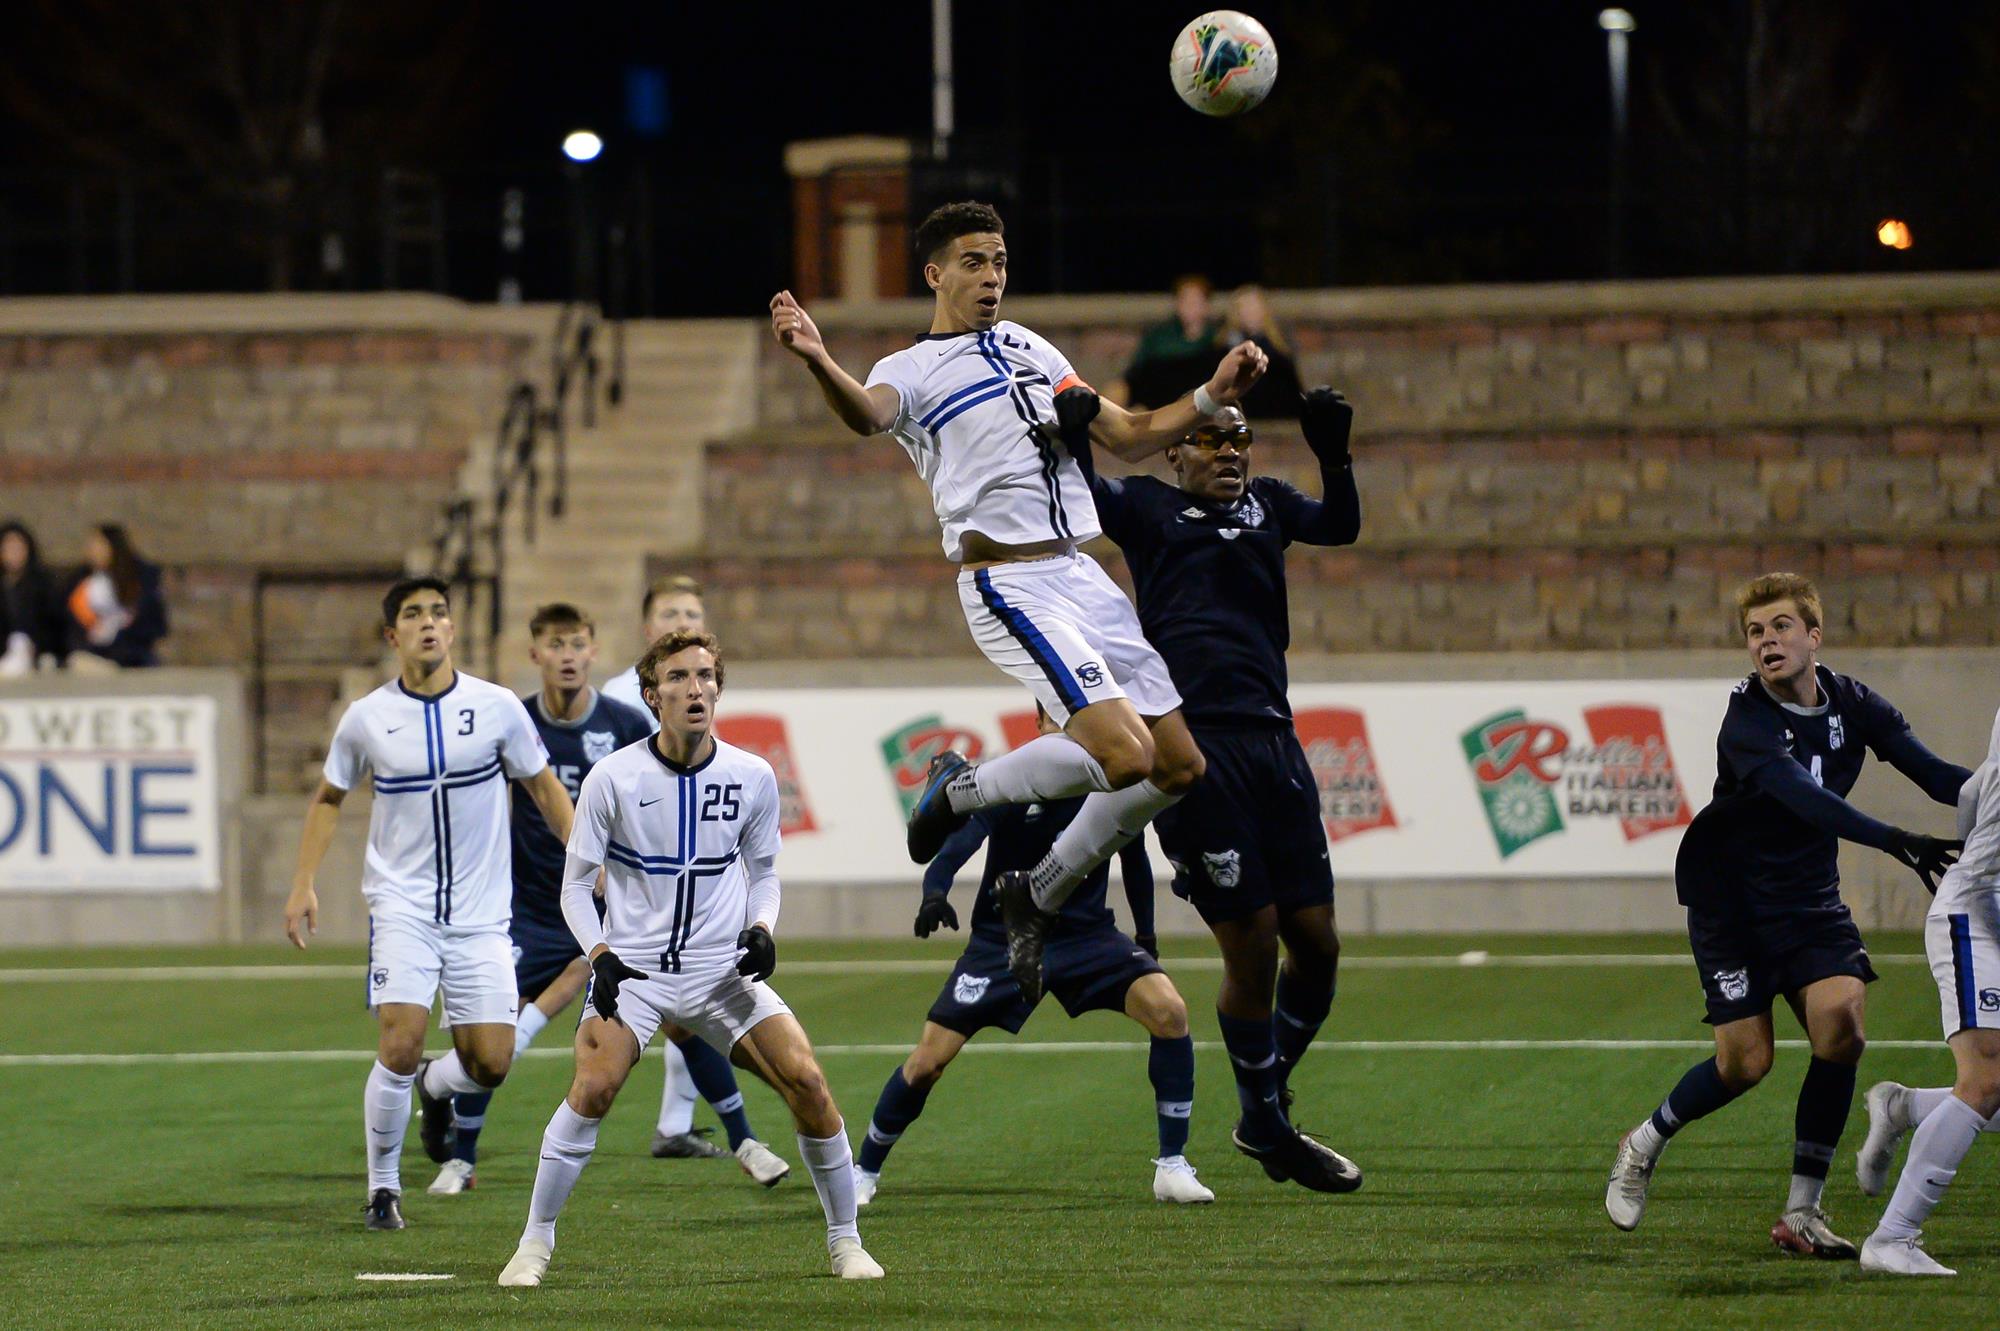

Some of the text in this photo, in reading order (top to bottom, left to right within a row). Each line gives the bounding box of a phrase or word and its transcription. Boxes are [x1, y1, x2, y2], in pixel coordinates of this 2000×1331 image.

[29, 708, 193, 744] WEST
[459, 709, 474, 735] 3
[1567, 771, 1676, 791] ITALIAN
[701, 783, 742, 821] 25
[1568, 796, 1679, 816] BAKERY
